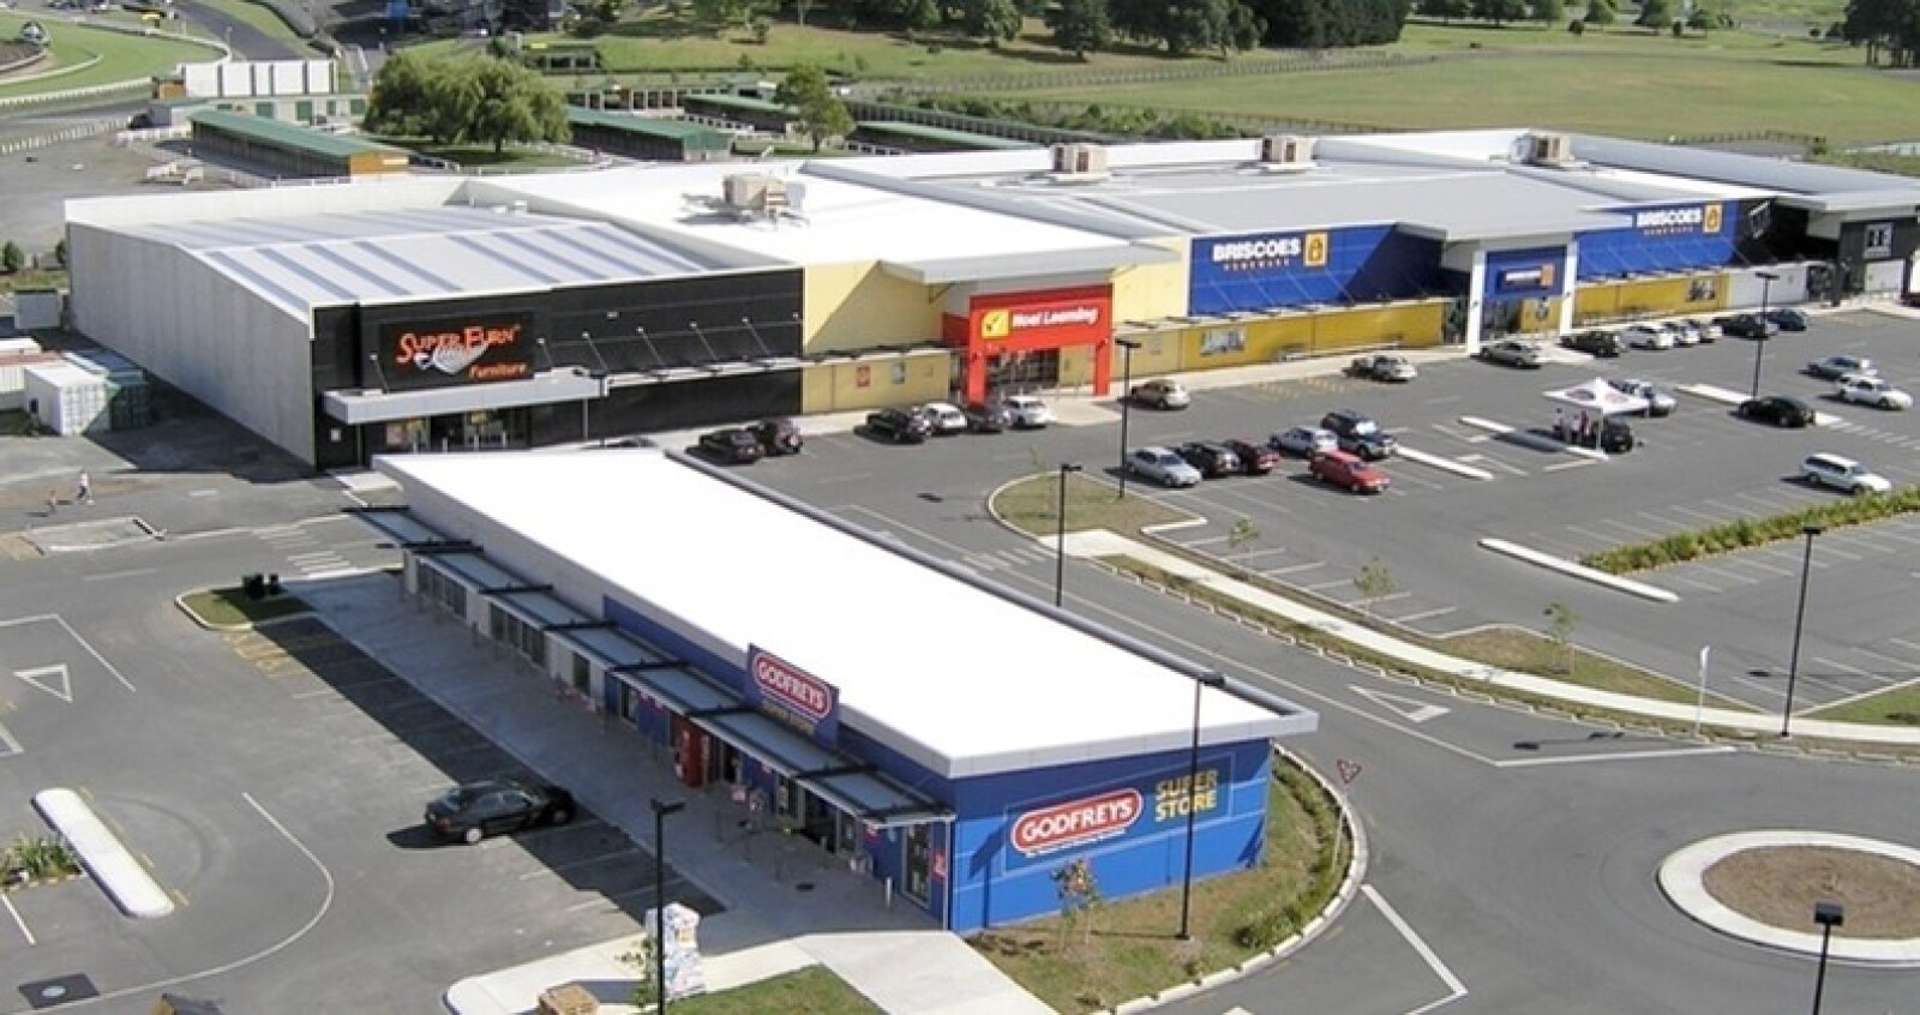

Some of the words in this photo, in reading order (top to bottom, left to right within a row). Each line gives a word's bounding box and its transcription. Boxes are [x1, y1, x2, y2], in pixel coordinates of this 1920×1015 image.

[1637, 206, 1701, 228] BRISCOES
[1213, 238, 1300, 262] BRISCOES
[758, 660, 826, 710] GODFREYS
[1156, 769, 1218, 801] SUPER
[1021, 797, 1133, 842] GODFREYS
[1155, 790, 1218, 822] STORE
